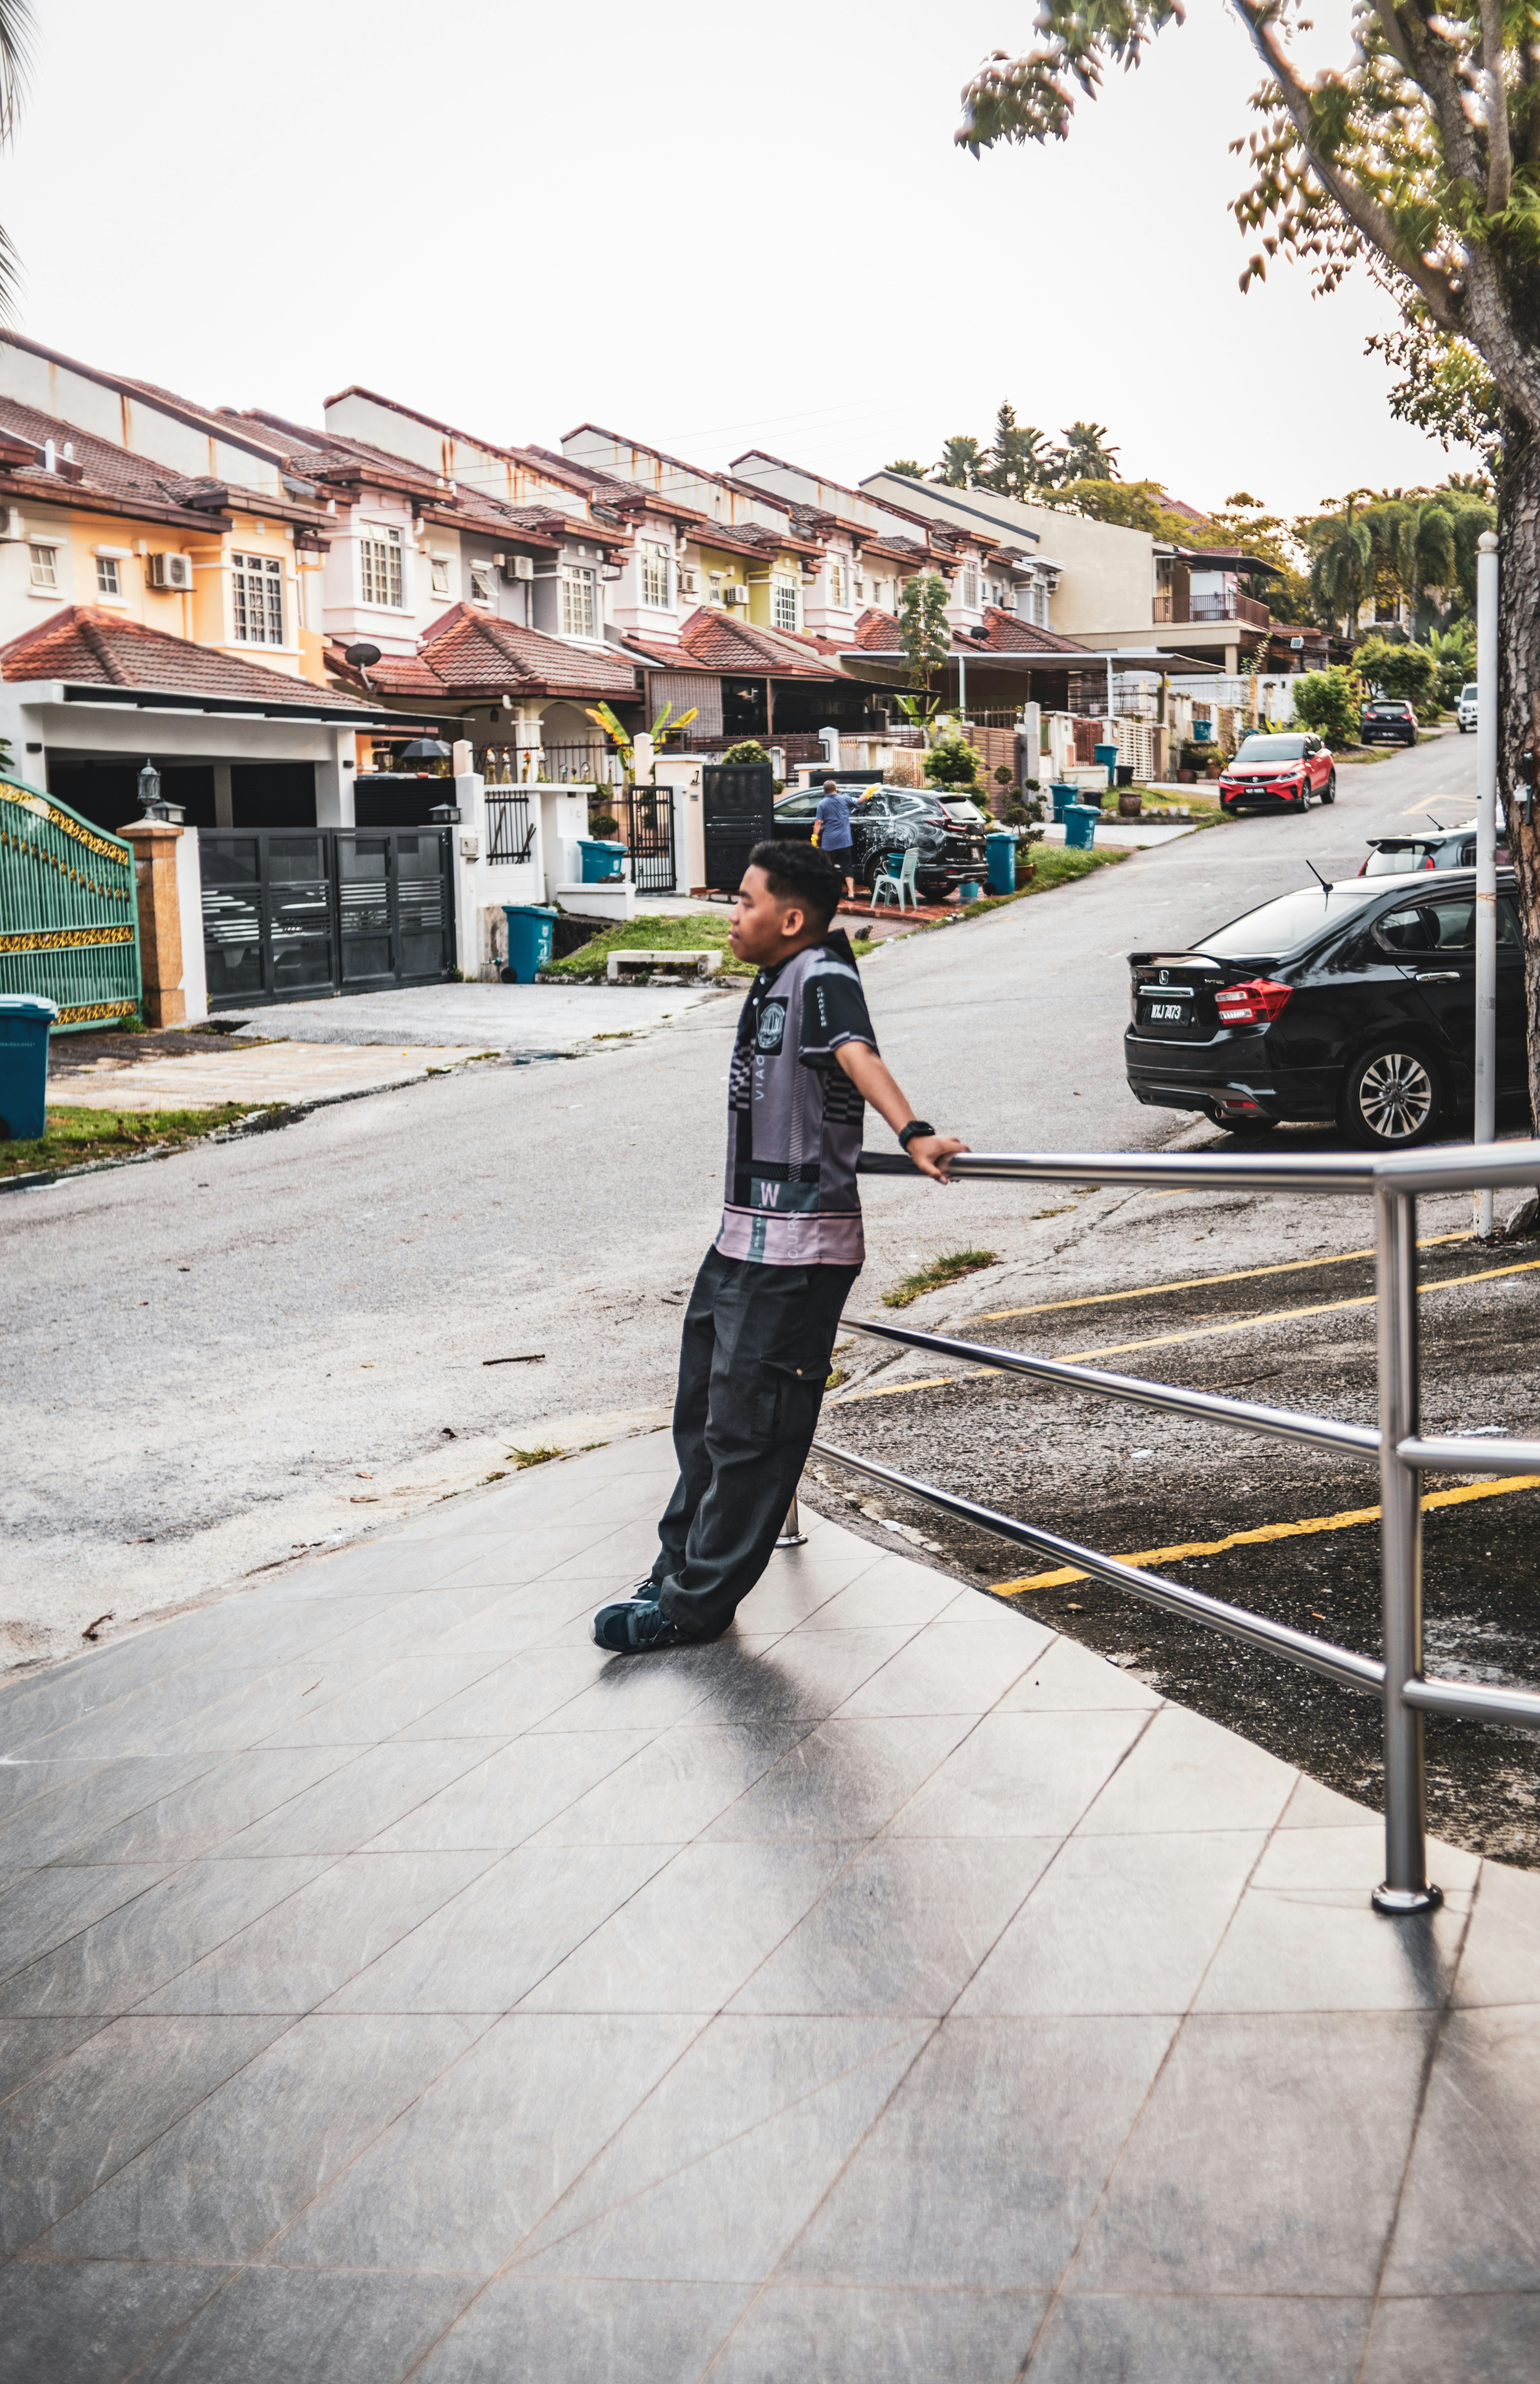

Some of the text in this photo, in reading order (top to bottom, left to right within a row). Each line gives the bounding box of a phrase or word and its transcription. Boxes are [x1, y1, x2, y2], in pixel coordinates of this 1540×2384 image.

[817, 986, 827, 1027] CHAPTER
[1151, 1004, 1182, 1020] WXJ 7473
[761, 1182, 780, 1208] W
[754, 1203, 763, 1249] CHAPTER
